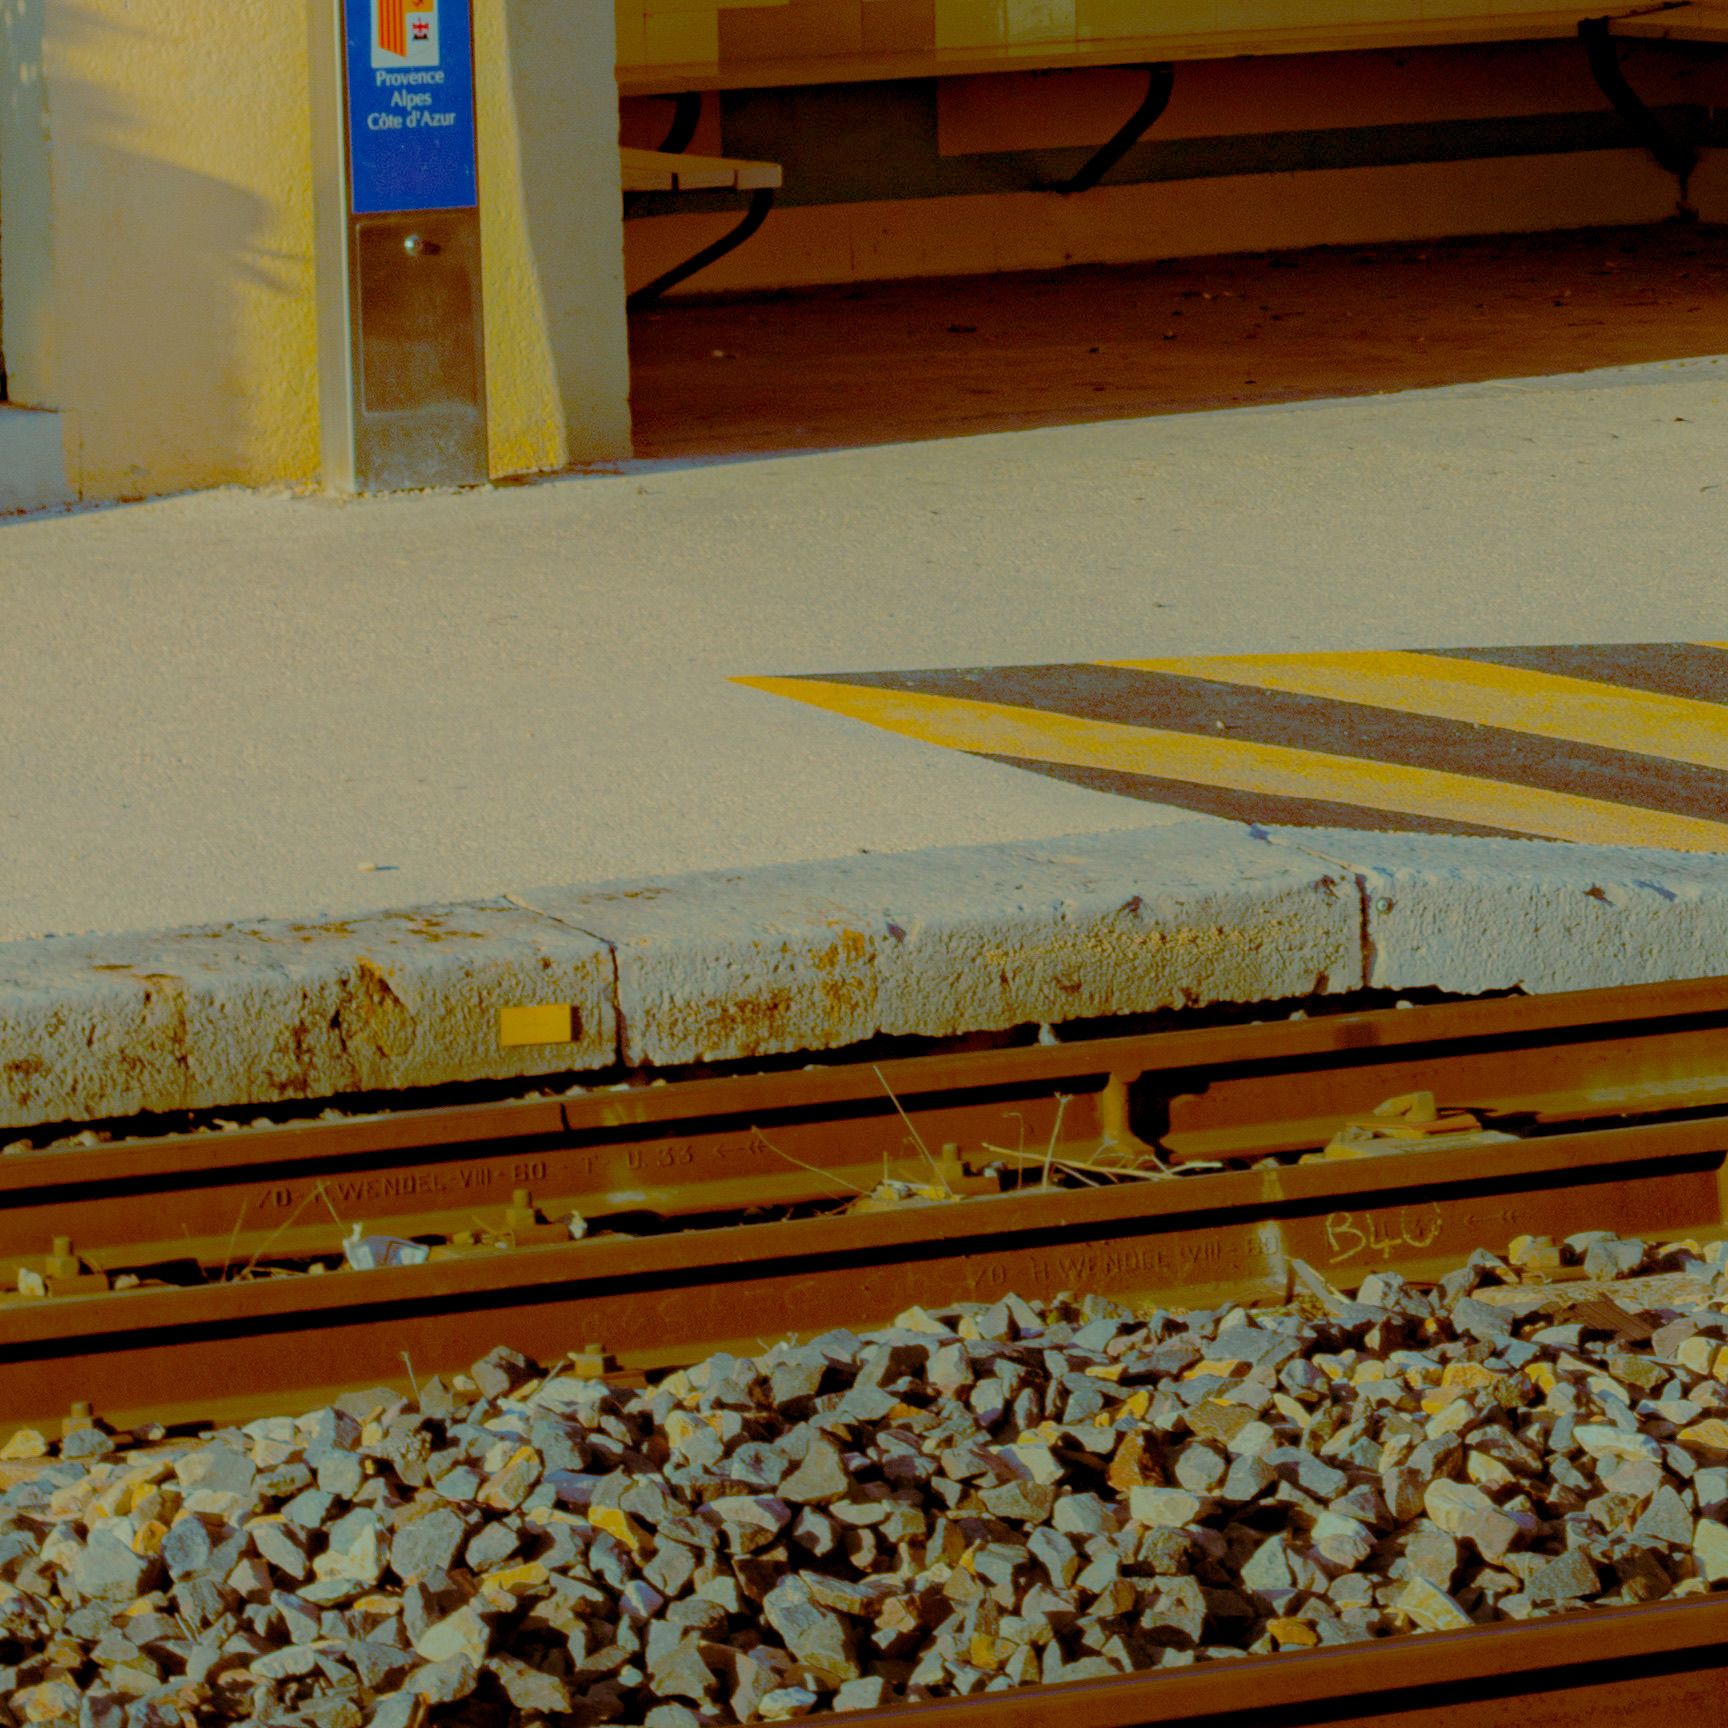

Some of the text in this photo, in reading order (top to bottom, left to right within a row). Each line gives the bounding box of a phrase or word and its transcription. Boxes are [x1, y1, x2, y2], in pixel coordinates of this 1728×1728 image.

[375, 70, 445, 87] Provence
[390, 89, 432, 110] Alpes
[367, 110, 456, 131] Côte d'Azur
